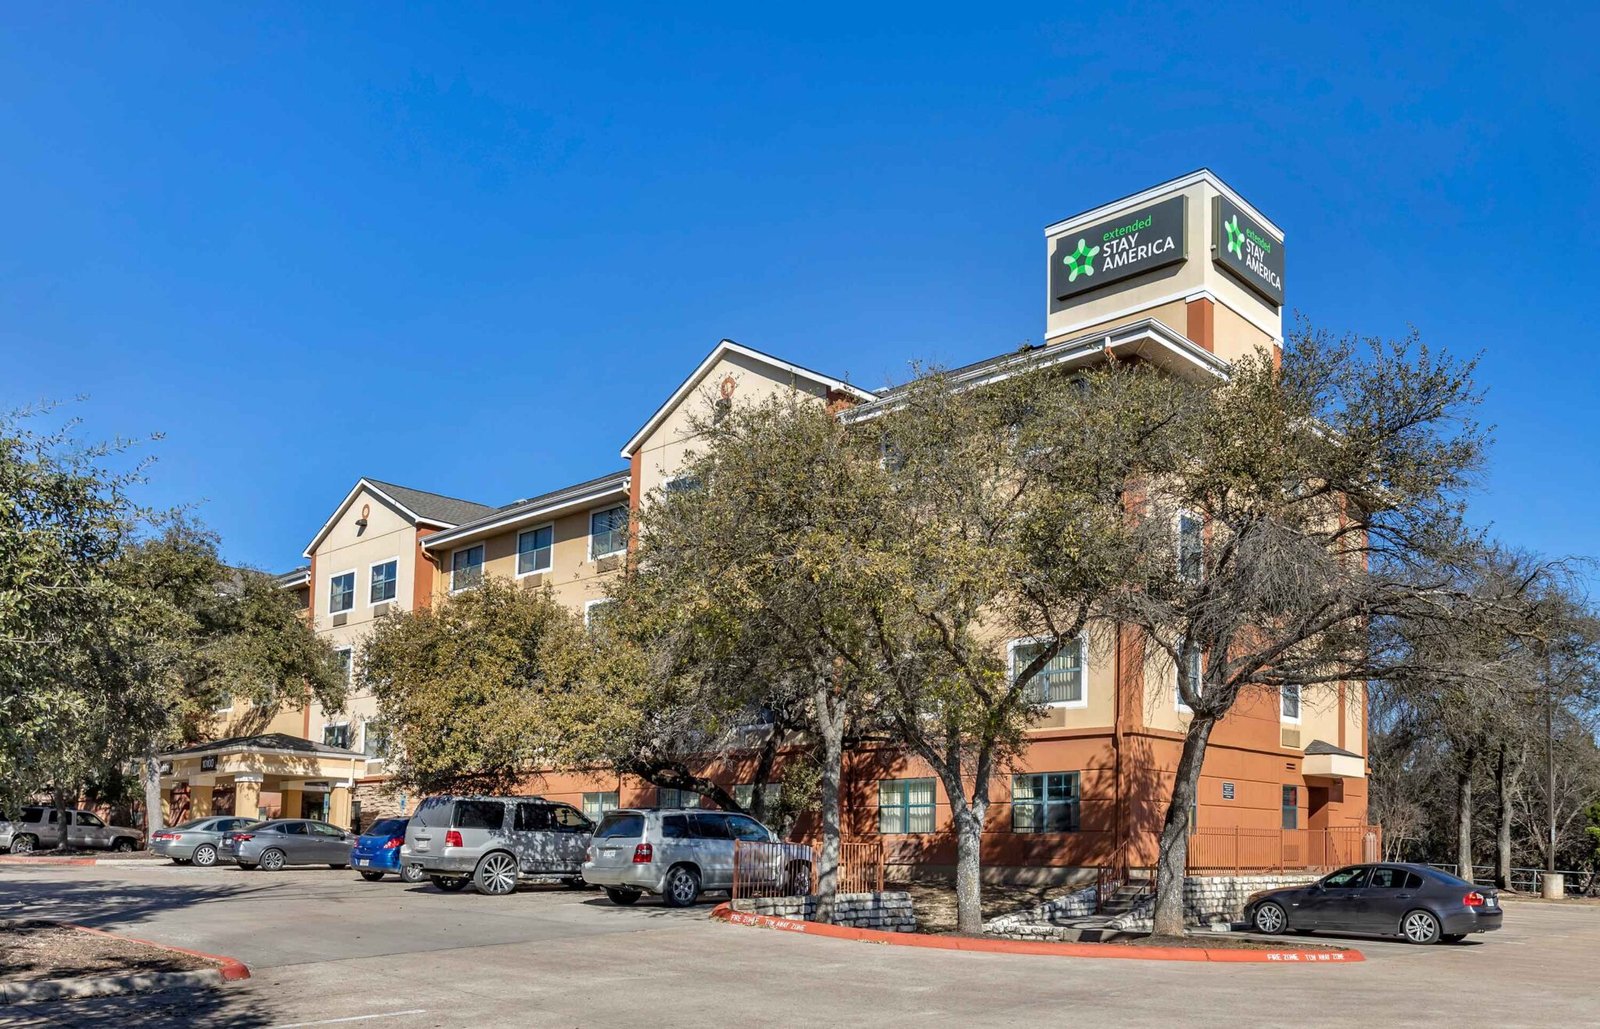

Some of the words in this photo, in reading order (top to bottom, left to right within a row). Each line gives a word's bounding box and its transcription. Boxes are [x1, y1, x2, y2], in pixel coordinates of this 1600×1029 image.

[1103, 215, 1152, 241] extended
[1246, 228, 1271, 253] extended
[1103, 232, 1139, 258] STAY
[1103, 236, 1176, 272] AMERICA
[1246, 238, 1265, 262] STAY
[1246, 253, 1282, 291] AMERICA
